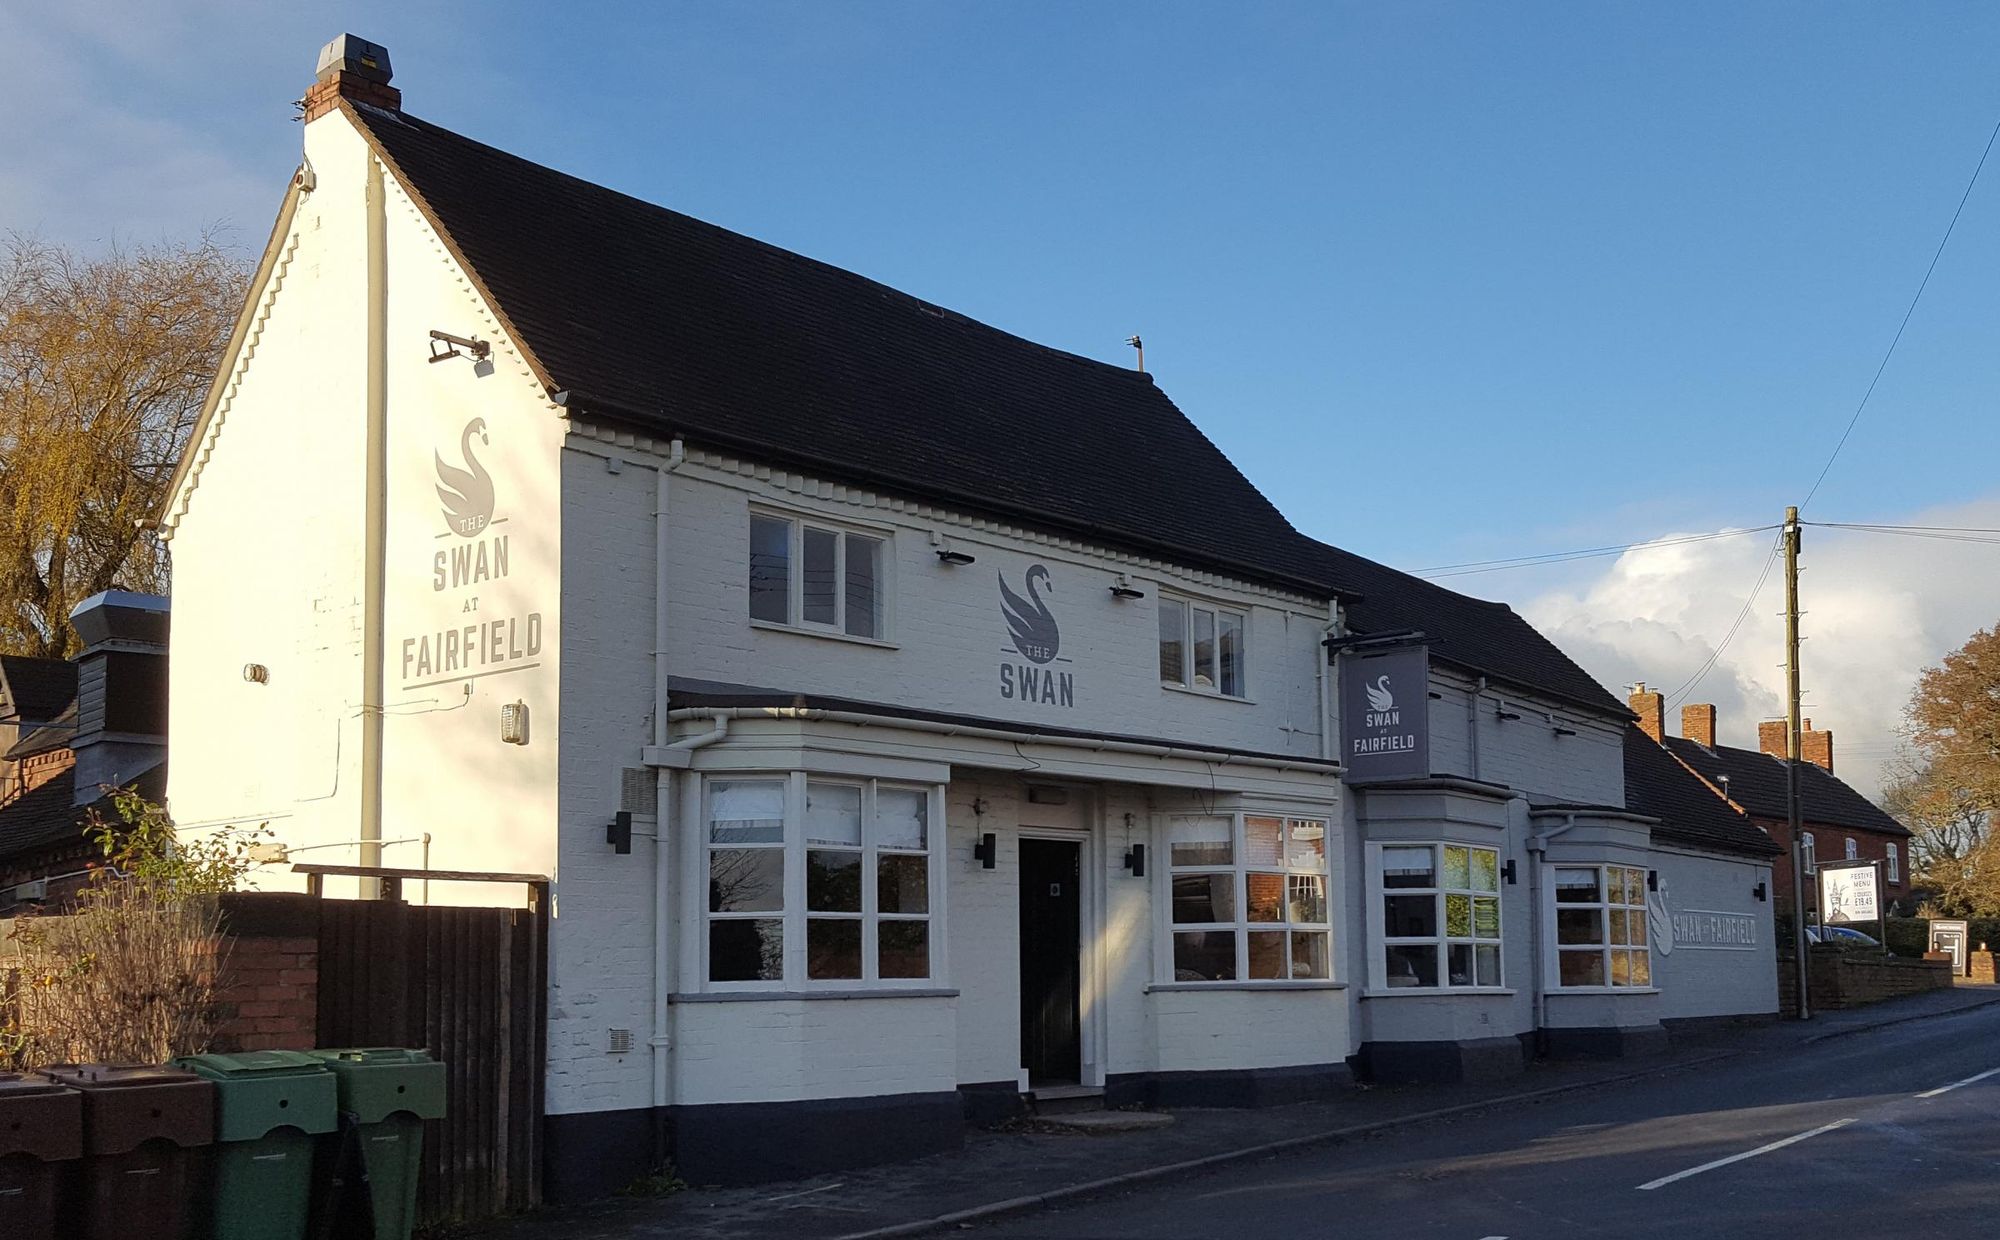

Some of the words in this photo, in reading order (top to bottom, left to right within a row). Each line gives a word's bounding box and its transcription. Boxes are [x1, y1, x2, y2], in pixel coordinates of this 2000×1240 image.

[459, 514, 484, 533] THE
[433, 535, 509, 592] SWAN
[462, 597, 479, 613] AT
[402, 612, 542, 680] FAIRFIELD
[1025, 645, 1051, 659] THE
[1000, 662, 1074, 708] SWAN
[1366, 711, 1399, 728] SWAN
[1354, 734, 1414, 753] FAIRFIELD
[1850, 871, 1873, 880] FESTIVE
[1853, 879, 1871, 888] MENU
[1673, 914, 1701, 944] SWAN
[1711, 916, 1756, 944] FAIRFIELD
